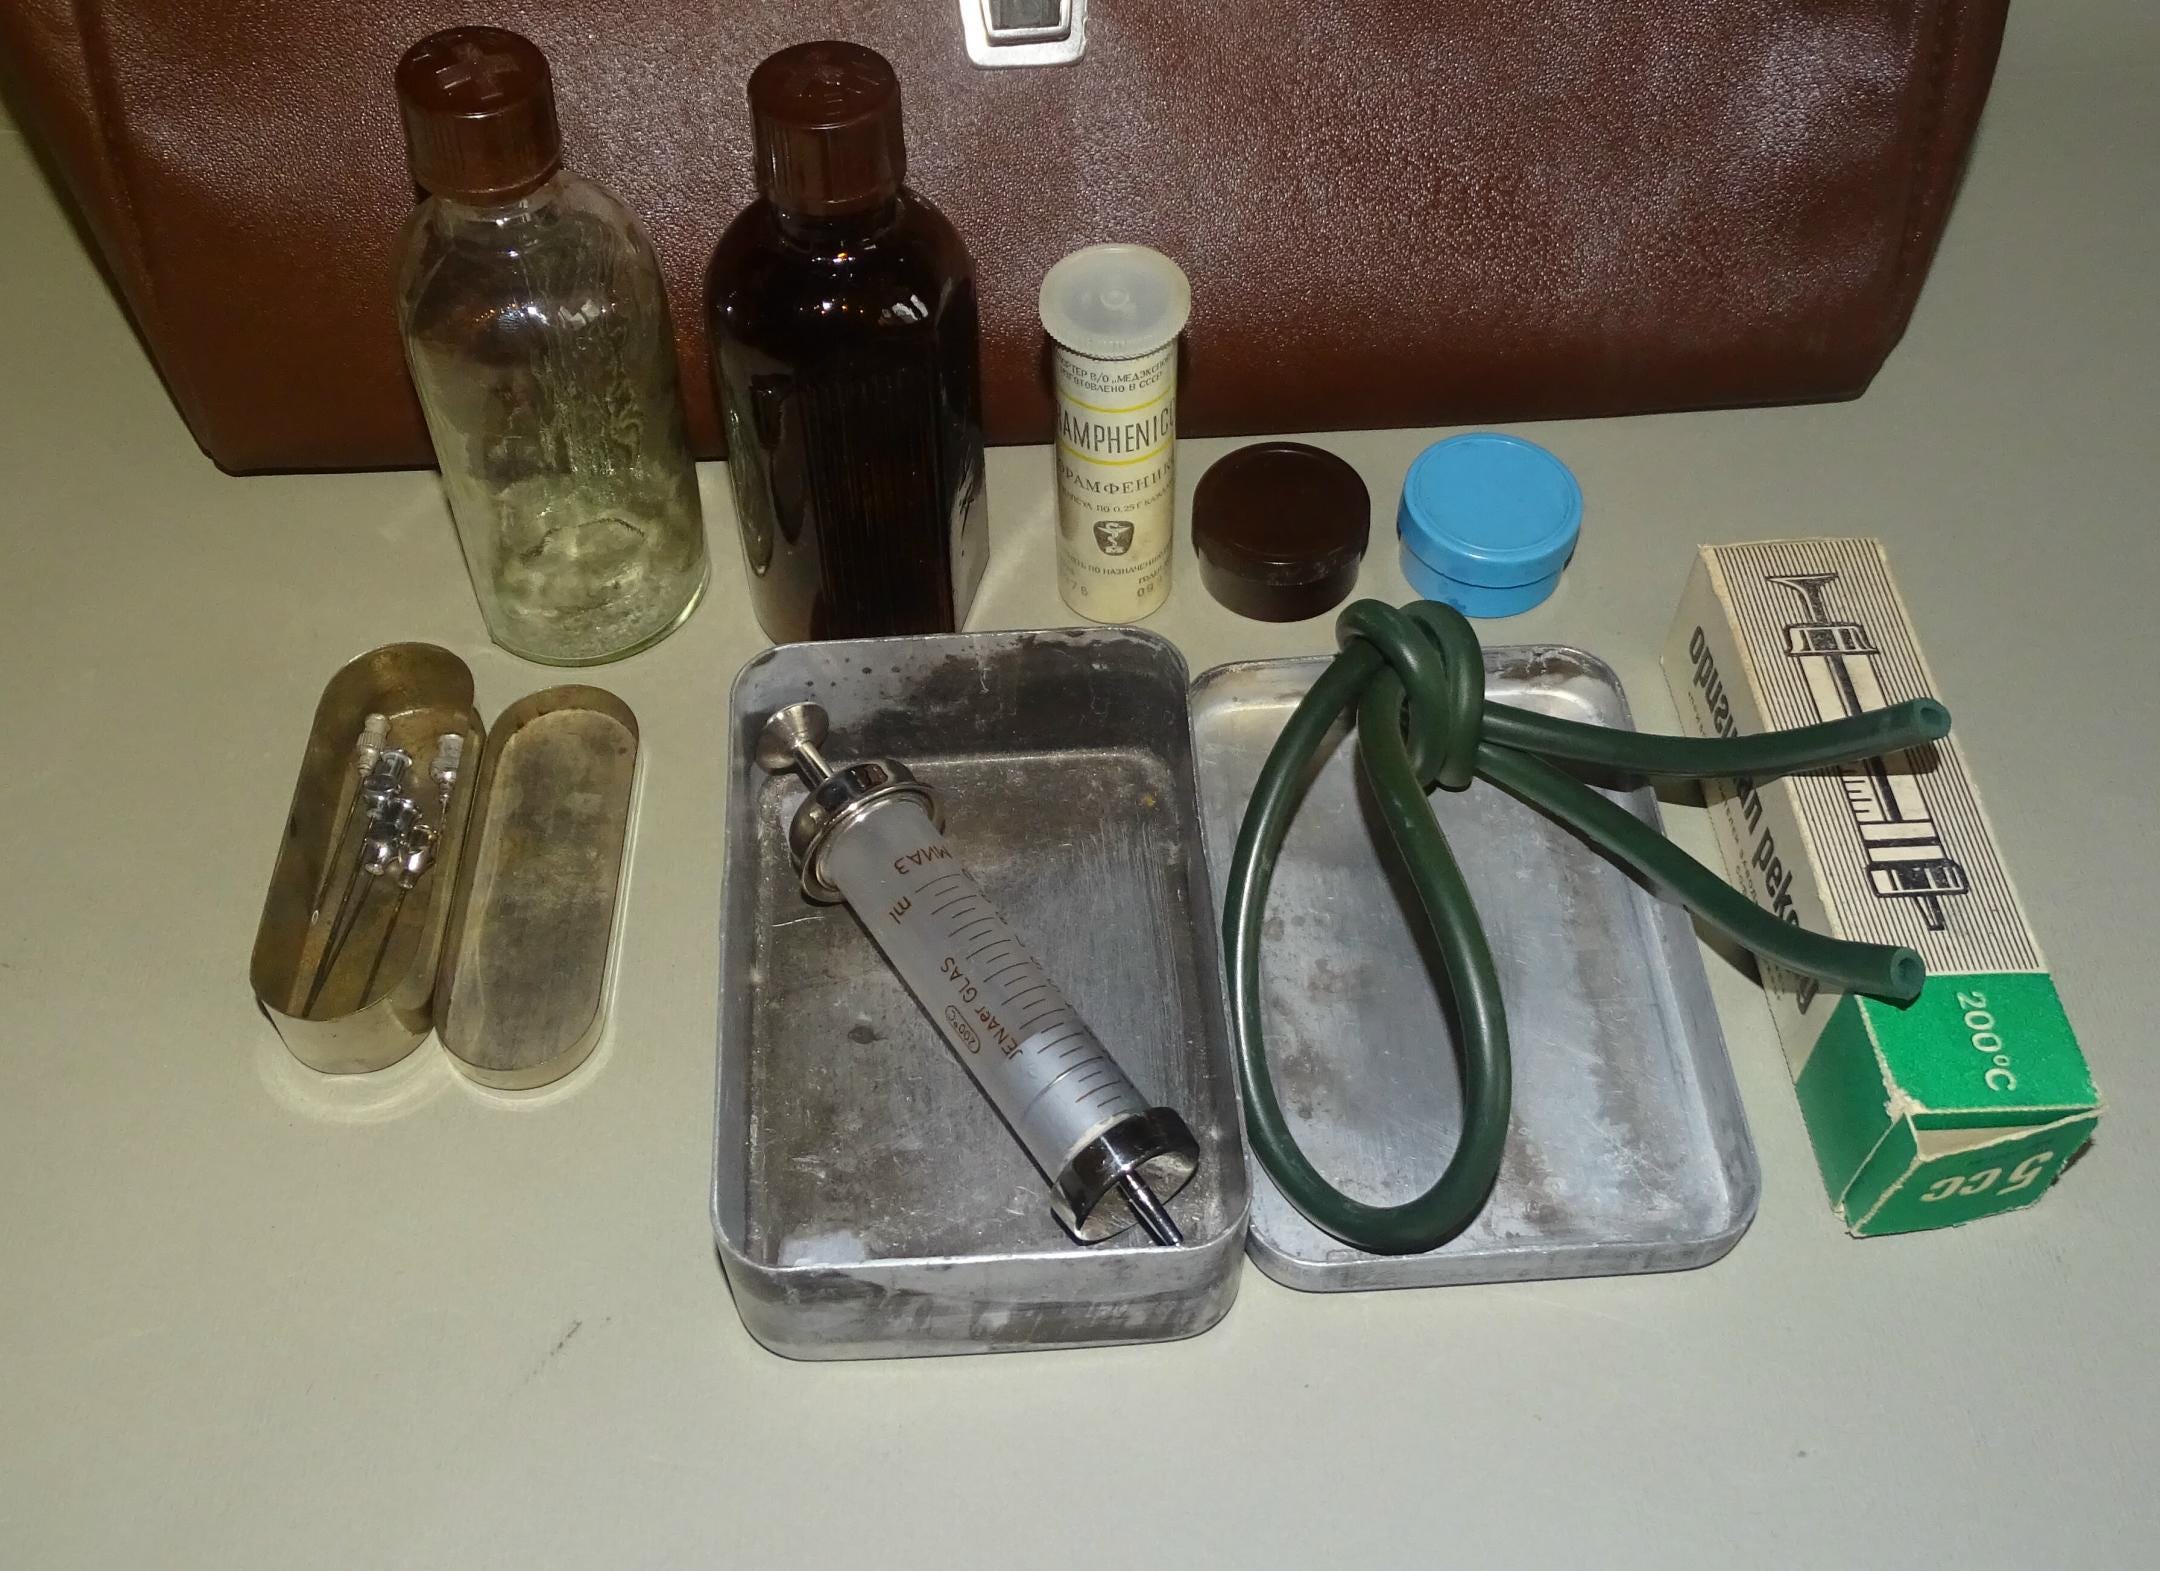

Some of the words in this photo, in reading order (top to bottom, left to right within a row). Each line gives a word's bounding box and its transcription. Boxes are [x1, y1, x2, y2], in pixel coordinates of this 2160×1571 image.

[888, 895, 912, 925] ml
[940, 956, 978, 1004] GLAS
[975, 1004, 1024, 1061] JENAer
[1956, 990, 2018, 1092] 200°C
